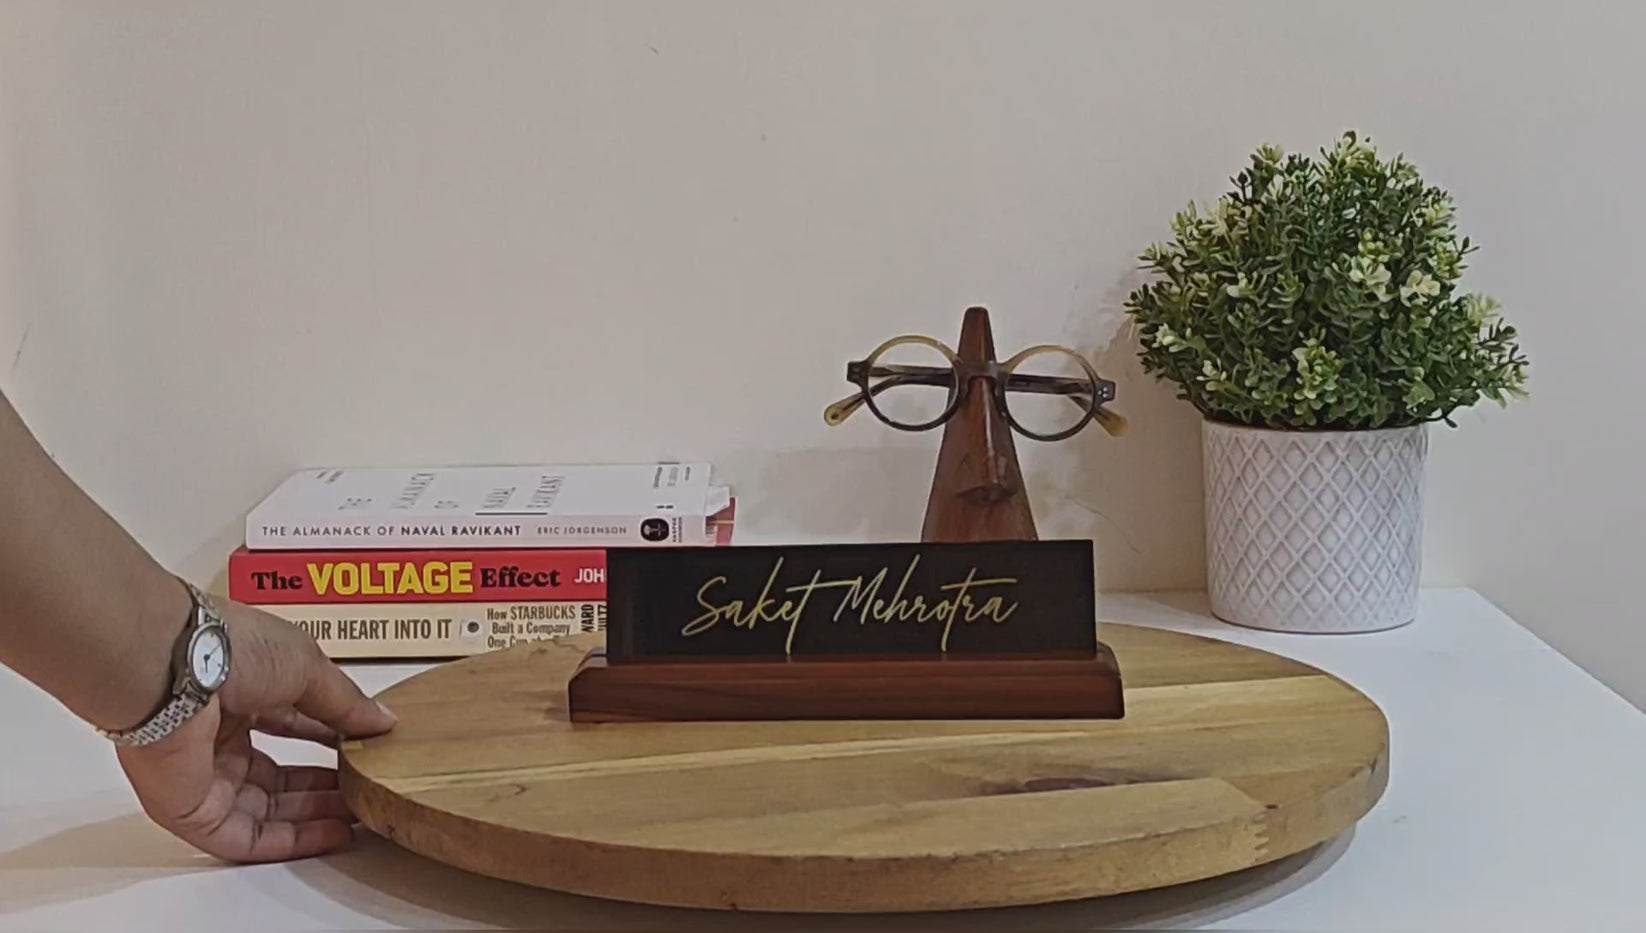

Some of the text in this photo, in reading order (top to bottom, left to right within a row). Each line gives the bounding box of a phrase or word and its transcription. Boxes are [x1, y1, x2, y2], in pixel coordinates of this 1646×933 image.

[262, 525, 521, 536] THE ALMANACK OF NAVAL RAVIKANT
[537, 526, 627, 535] ERIC JORGENSON
[251, 562, 561, 596] The VOLTAGE Effect
[682, 554, 1018, 655] Saket Mehrotra
[487, 605, 576, 620] How STARBUCKS
[289, 619, 453, 640] OUR HEART INTO IT
[492, 622, 570, 636] Built a Company
[488, 635, 506, 648] One
